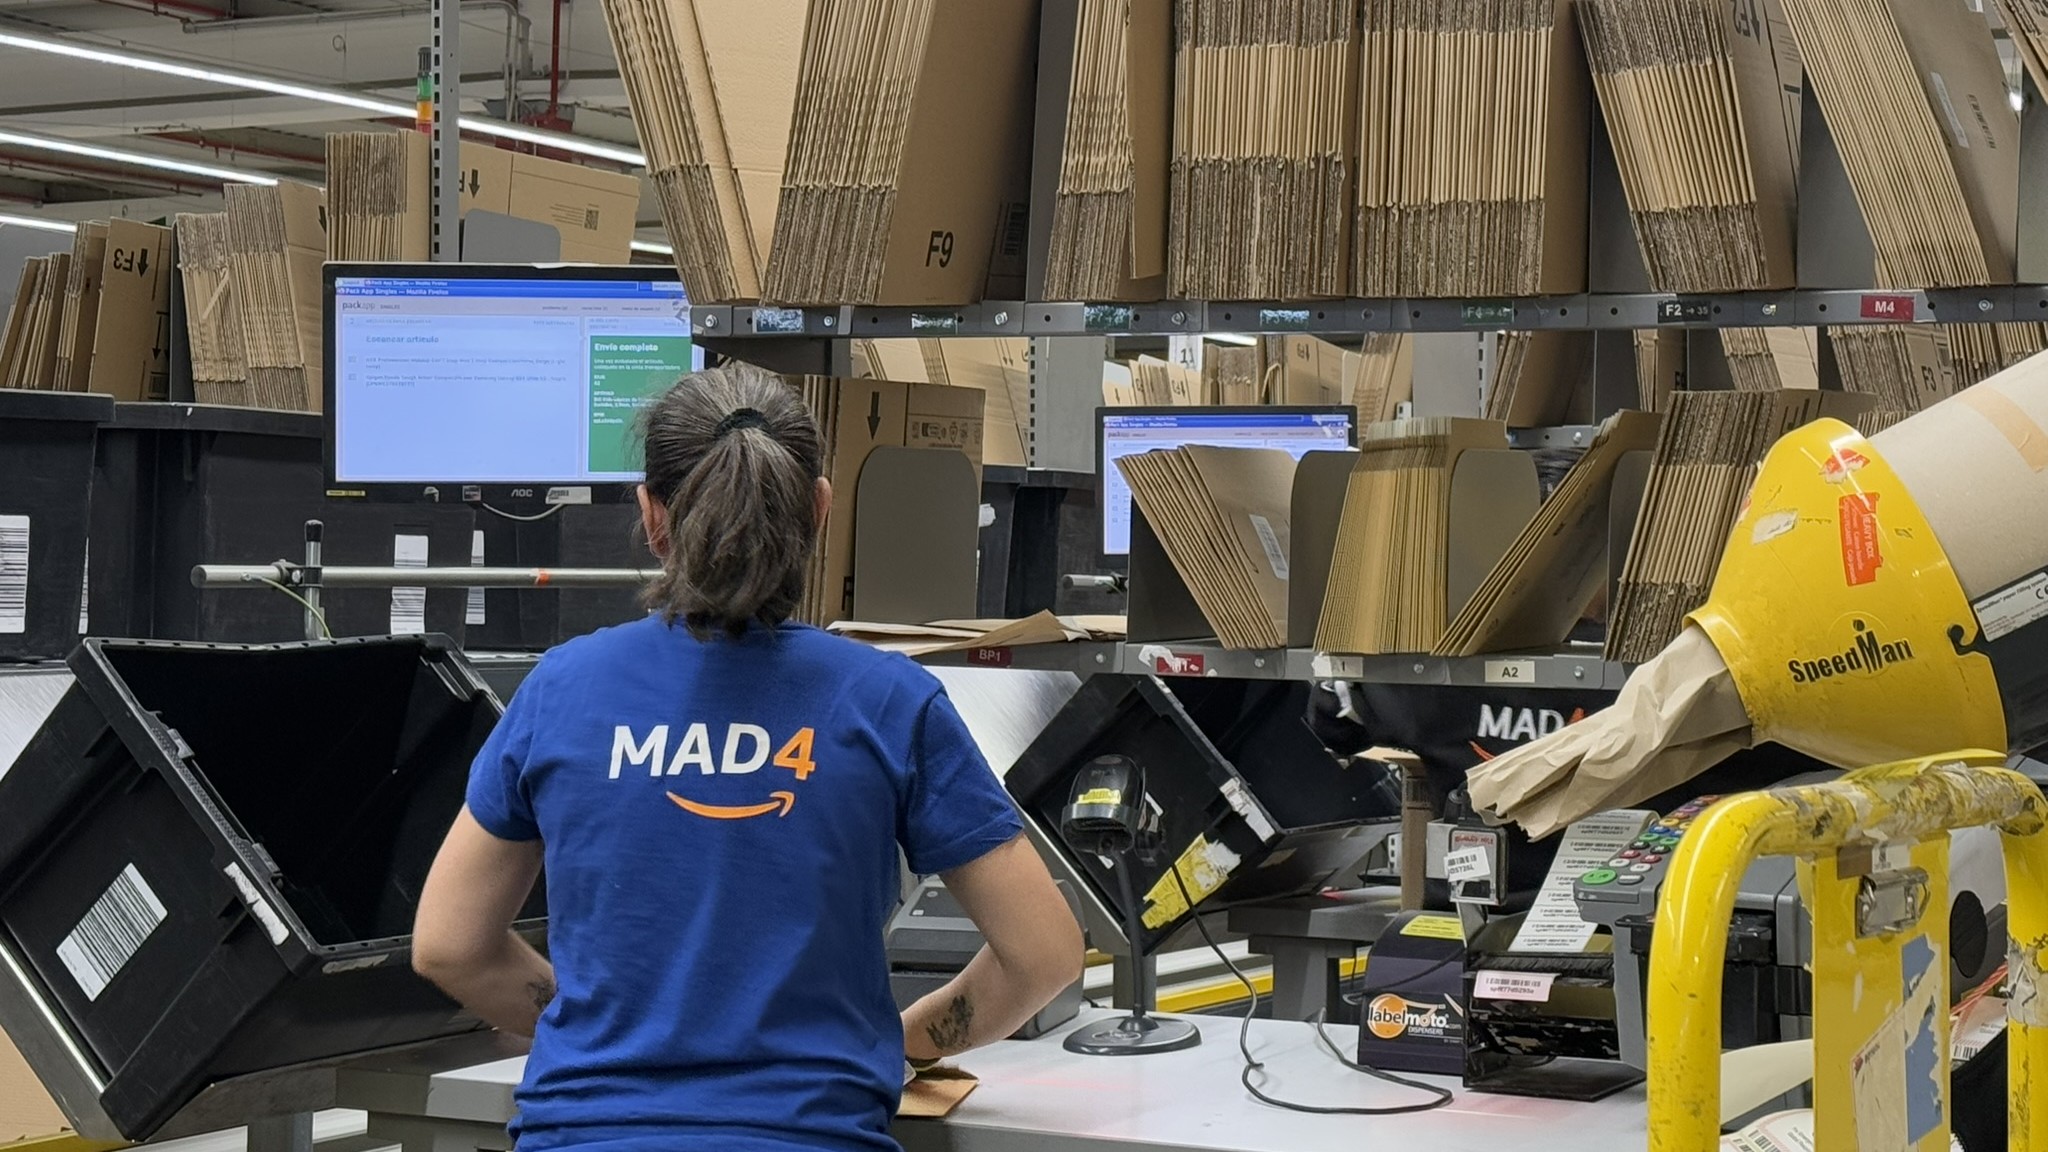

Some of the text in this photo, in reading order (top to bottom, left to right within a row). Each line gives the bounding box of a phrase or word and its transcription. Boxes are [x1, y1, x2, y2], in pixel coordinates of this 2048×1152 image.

[925, 230, 954, 268] F9
[113, 248, 135, 273] F3
[1665, 304, 1683, 316] F2
[1875, 300, 1895, 313] M4
[619, 342, 659, 353] completo
[1921, 365, 1937, 392] F3
[511, 488, 533, 498] AOC
[978, 649, 1001, 662] BP1
[1787, 618, 1915, 683] SpeedMan
[1501, 667, 1519, 678] A2
[608, 723, 817, 780] MAD4
[1408, 1026, 1444, 1036] DISPENSERS
